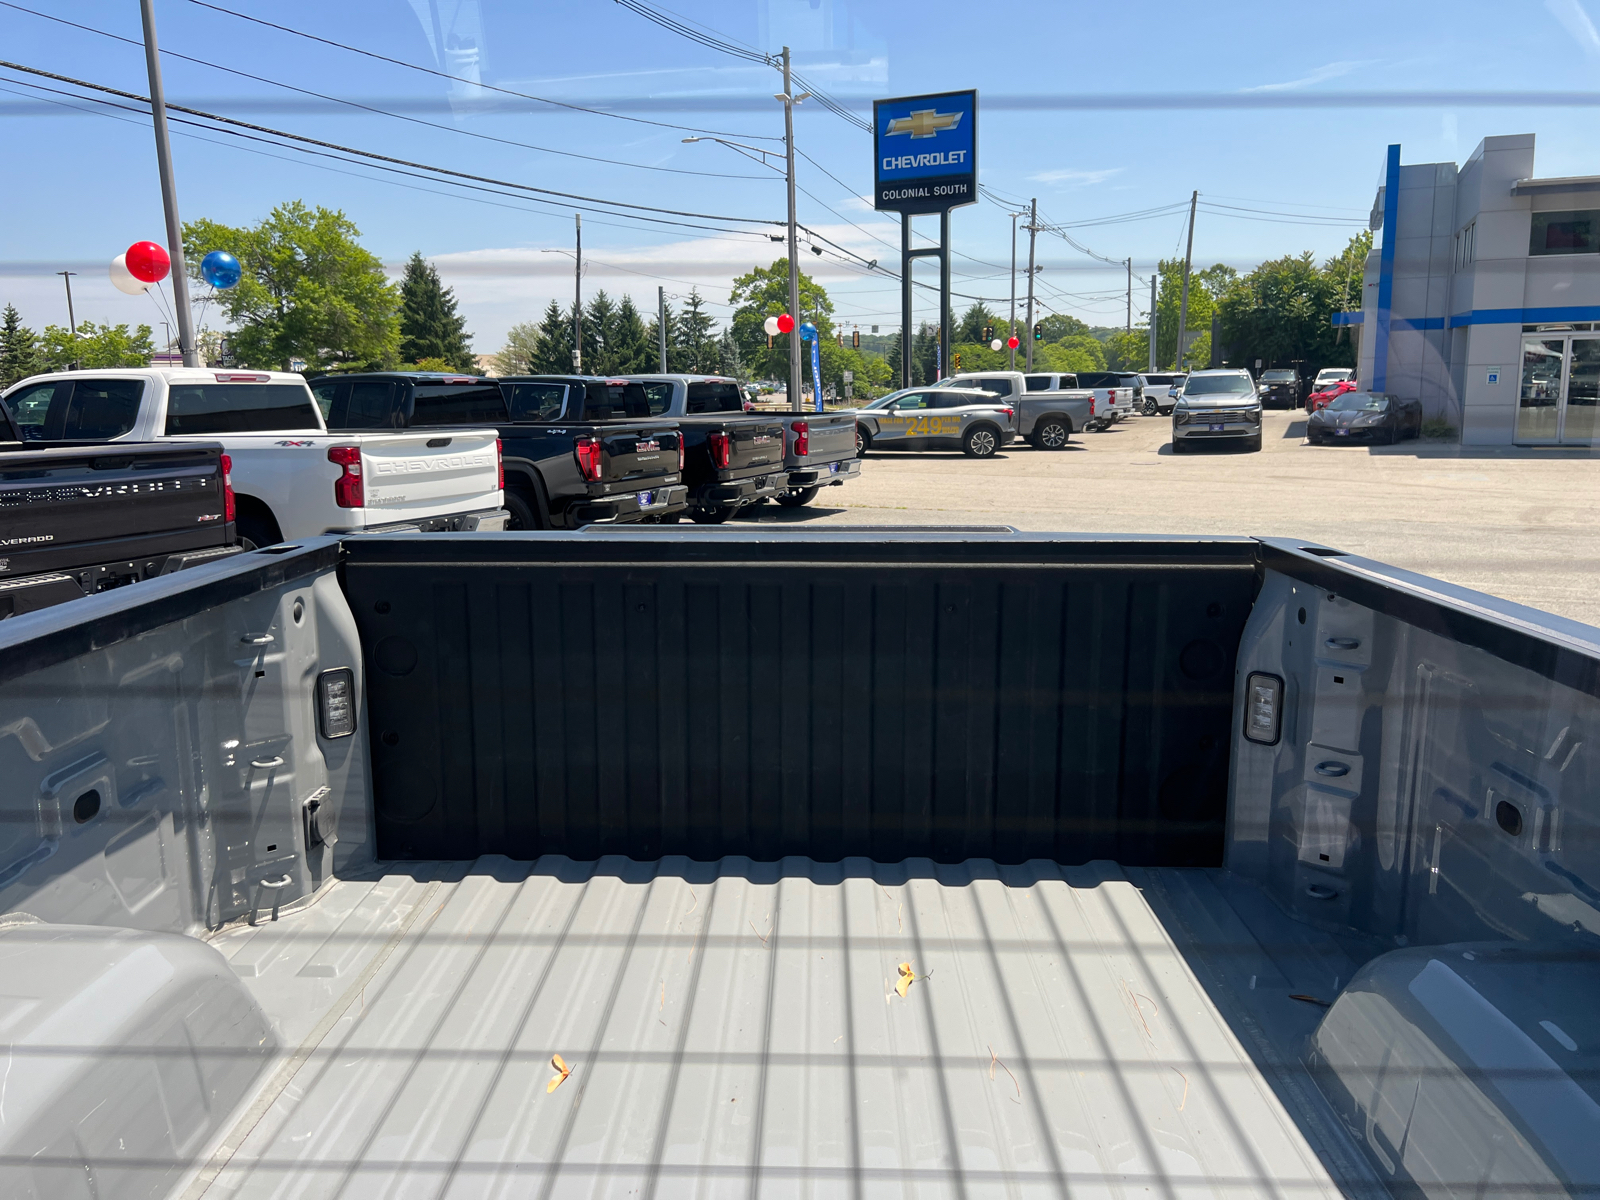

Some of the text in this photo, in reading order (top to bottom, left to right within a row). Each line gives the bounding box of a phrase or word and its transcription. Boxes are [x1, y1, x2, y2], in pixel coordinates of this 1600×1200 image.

[882, 150, 967, 171] CHEVROLET
[882, 183, 968, 201] COLONIAL SOUTH
[635, 440, 661, 453] GMC
[376, 454, 493, 476] CHEVROLET
